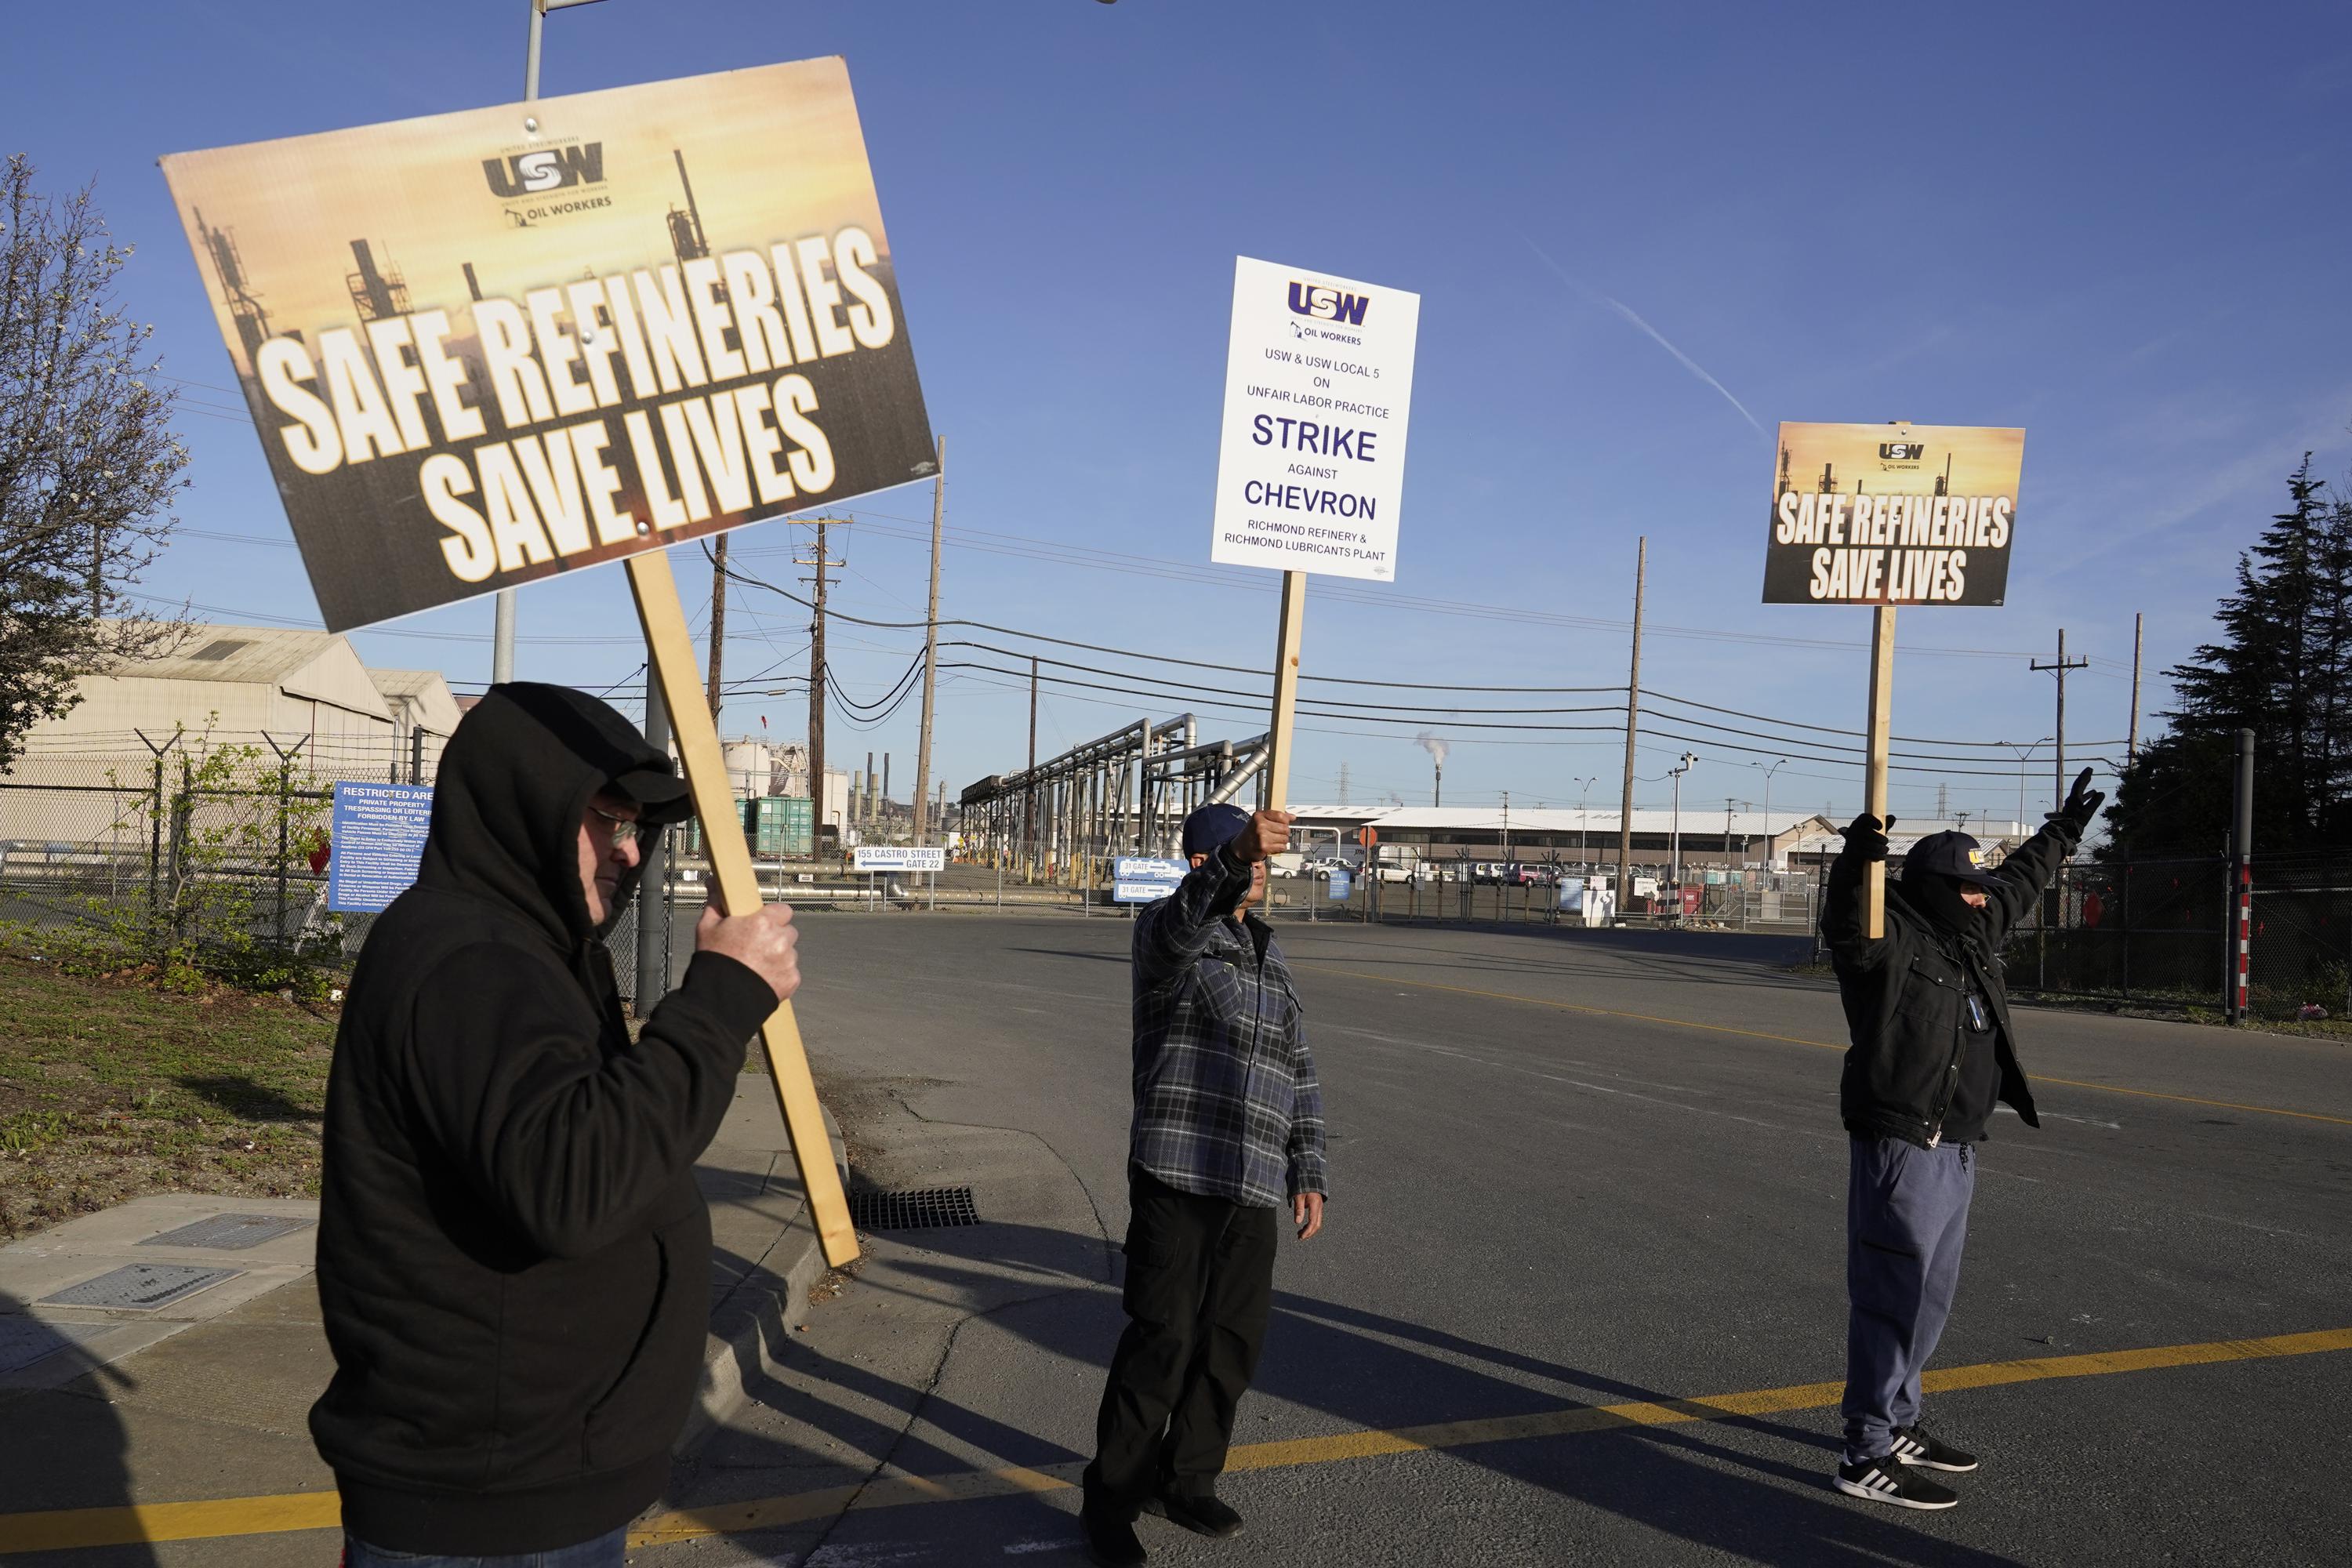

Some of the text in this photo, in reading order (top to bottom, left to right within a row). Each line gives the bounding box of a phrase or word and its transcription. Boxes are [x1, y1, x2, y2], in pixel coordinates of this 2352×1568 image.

[481, 141, 604, 198] USW
[527, 196, 612, 220] OIL WORKERS
[1287, 281, 1370, 326] USW
[257, 227, 895, 475] SAFE REFINERIES
[1304, 328, 1361, 346] OIL WORKERS
[1265, 348, 1380, 379] USW & USW LOCAL 5
[1313, 376, 1330, 389] ON
[1247, 385, 1389, 419] UNFAIR LABOR PRACTICE
[1252, 414, 1377, 463] STRIKE
[1878, 444, 1925, 460] USW
[419, 374, 836, 583] SAVE LIVES
[1287, 463, 1338, 480] AGAINST
[1244, 480, 1376, 521] CHEVRON
[1247, 520, 1367, 543] RICHMOND REFINERY &
[1777, 492, 2011, 548] SAFE REFINERIES
[1225, 533, 1385, 562] RICHMOND LUBRICANTS PLANT
[1809, 547, 1967, 601] SAVE LIVES
[343, 787, 434, 800] RESTRICTED ARE
[343, 804, 391, 814] TRESPASSING
[875, 850, 908, 858] CASTRO
[911, 850, 942, 858] STREET
